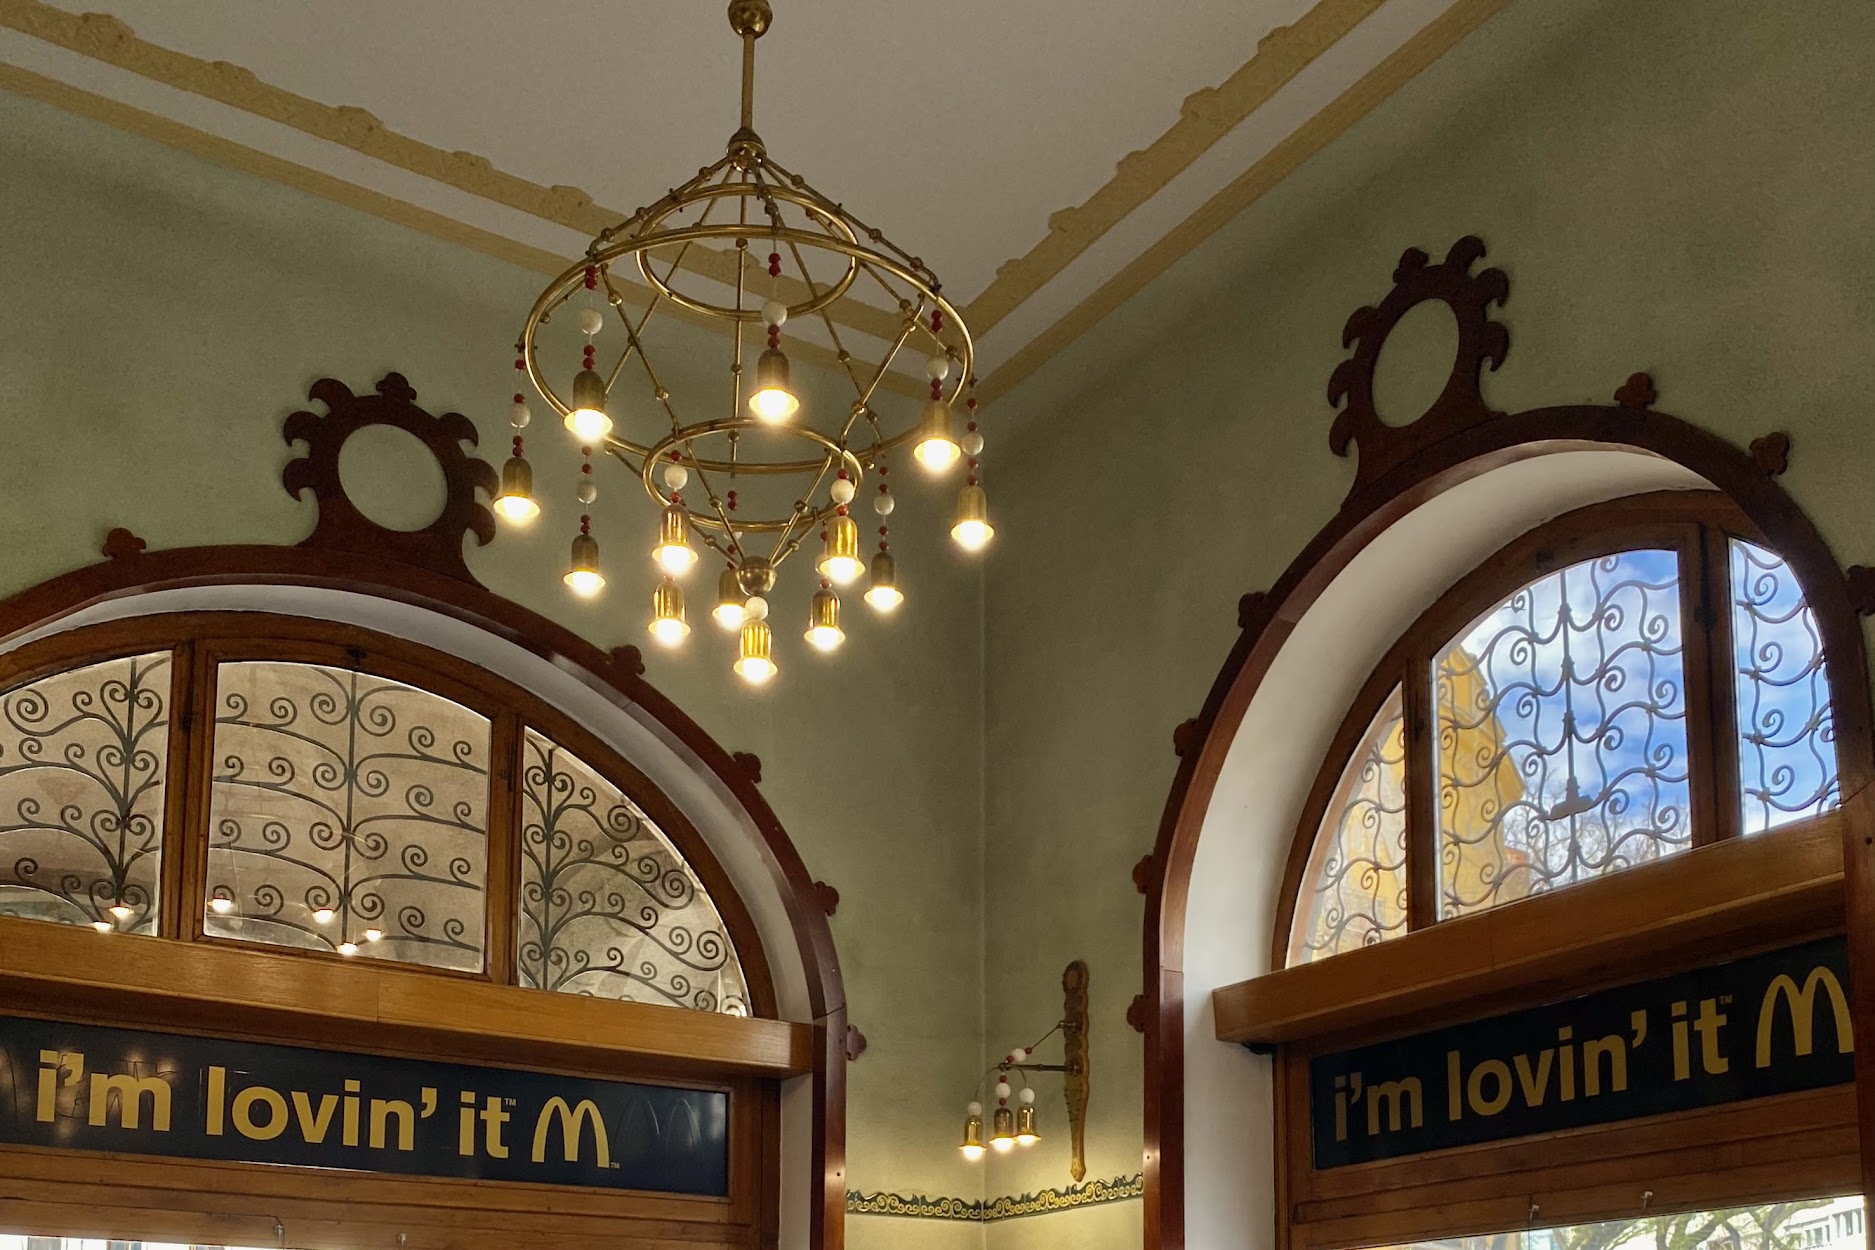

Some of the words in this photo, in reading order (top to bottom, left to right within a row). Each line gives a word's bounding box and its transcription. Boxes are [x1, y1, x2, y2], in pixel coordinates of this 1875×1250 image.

[36, 1050, 171, 1132] i'm
[205, 1066, 436, 1151] lovin'
[1335, 1071, 1424, 1141] i'm
[1447, 1009, 1648, 1122] lovin'
